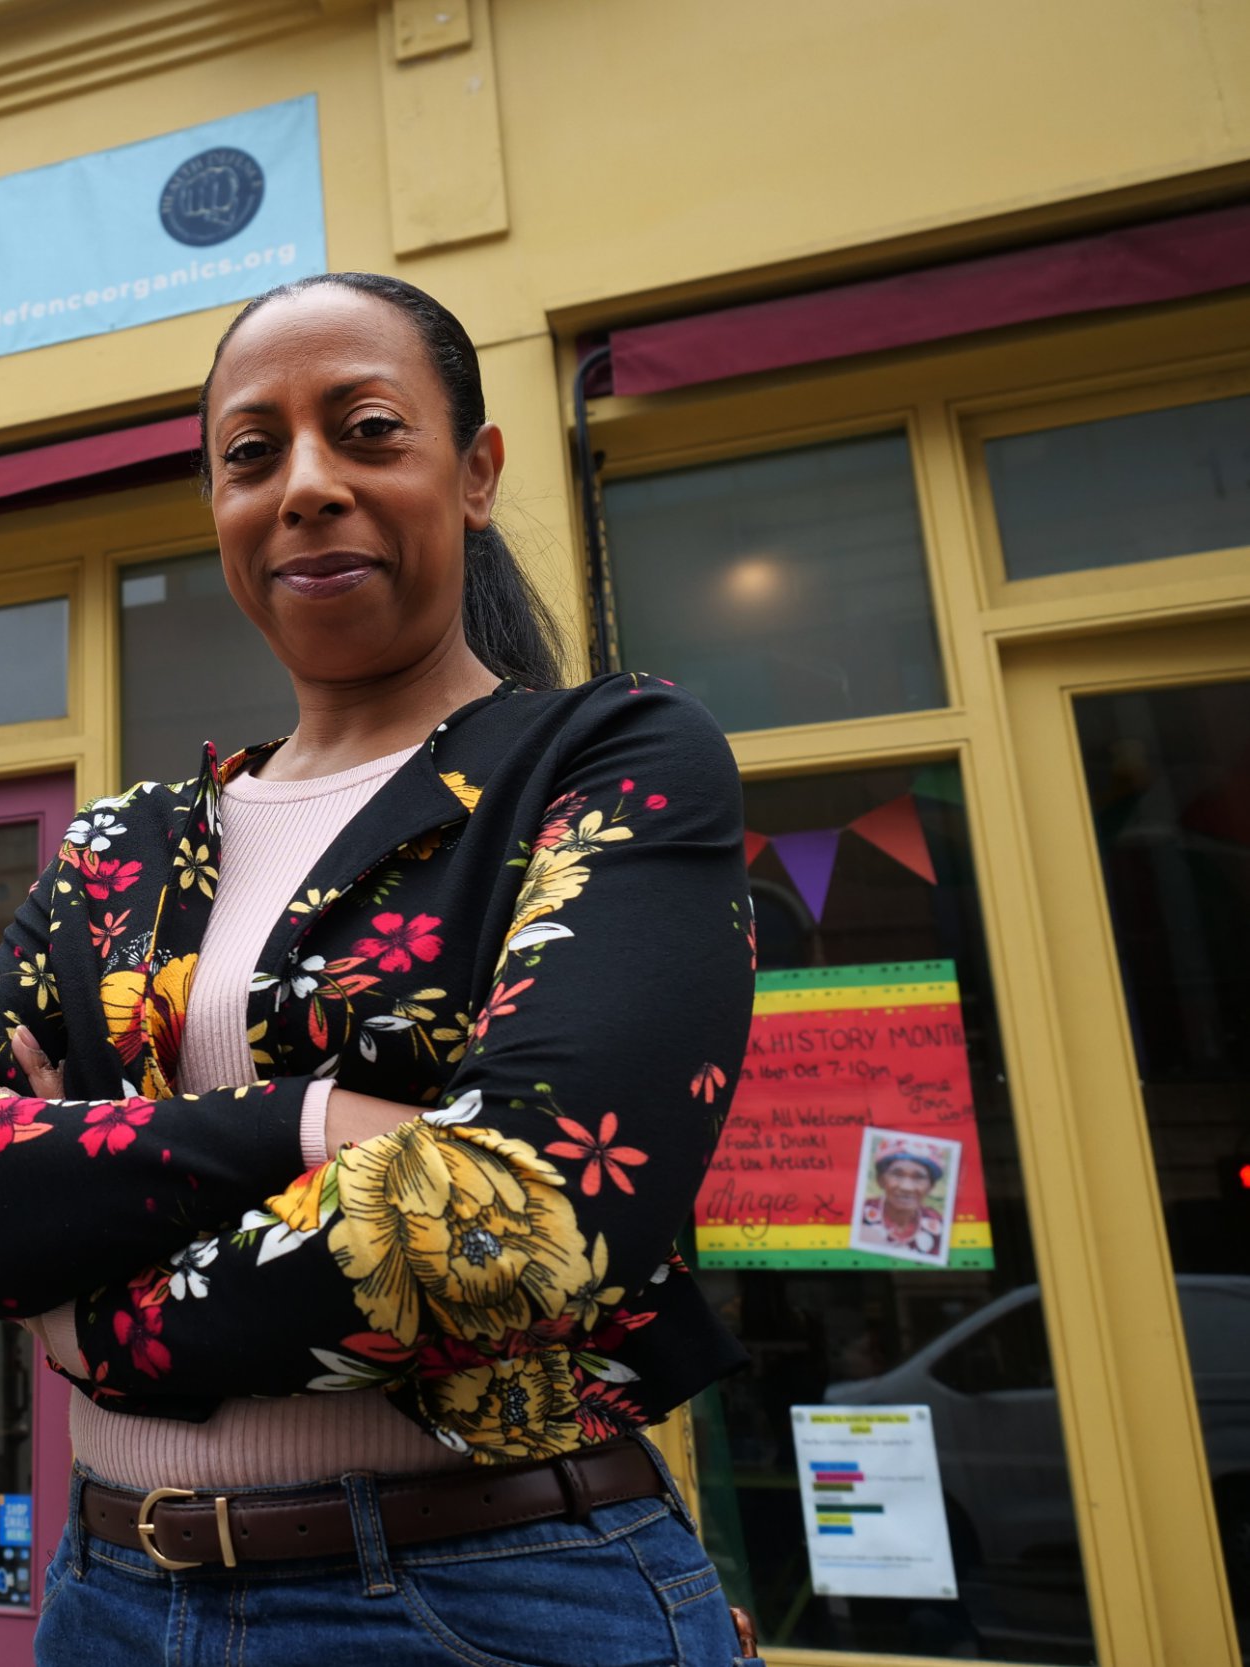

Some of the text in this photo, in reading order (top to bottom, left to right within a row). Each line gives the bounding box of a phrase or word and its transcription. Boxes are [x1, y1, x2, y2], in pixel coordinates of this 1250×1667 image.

[770, 1027, 879, 1054] HISTORY
[889, 1023, 965, 1047] MONTH
[771, 1106, 794, 1127] All
